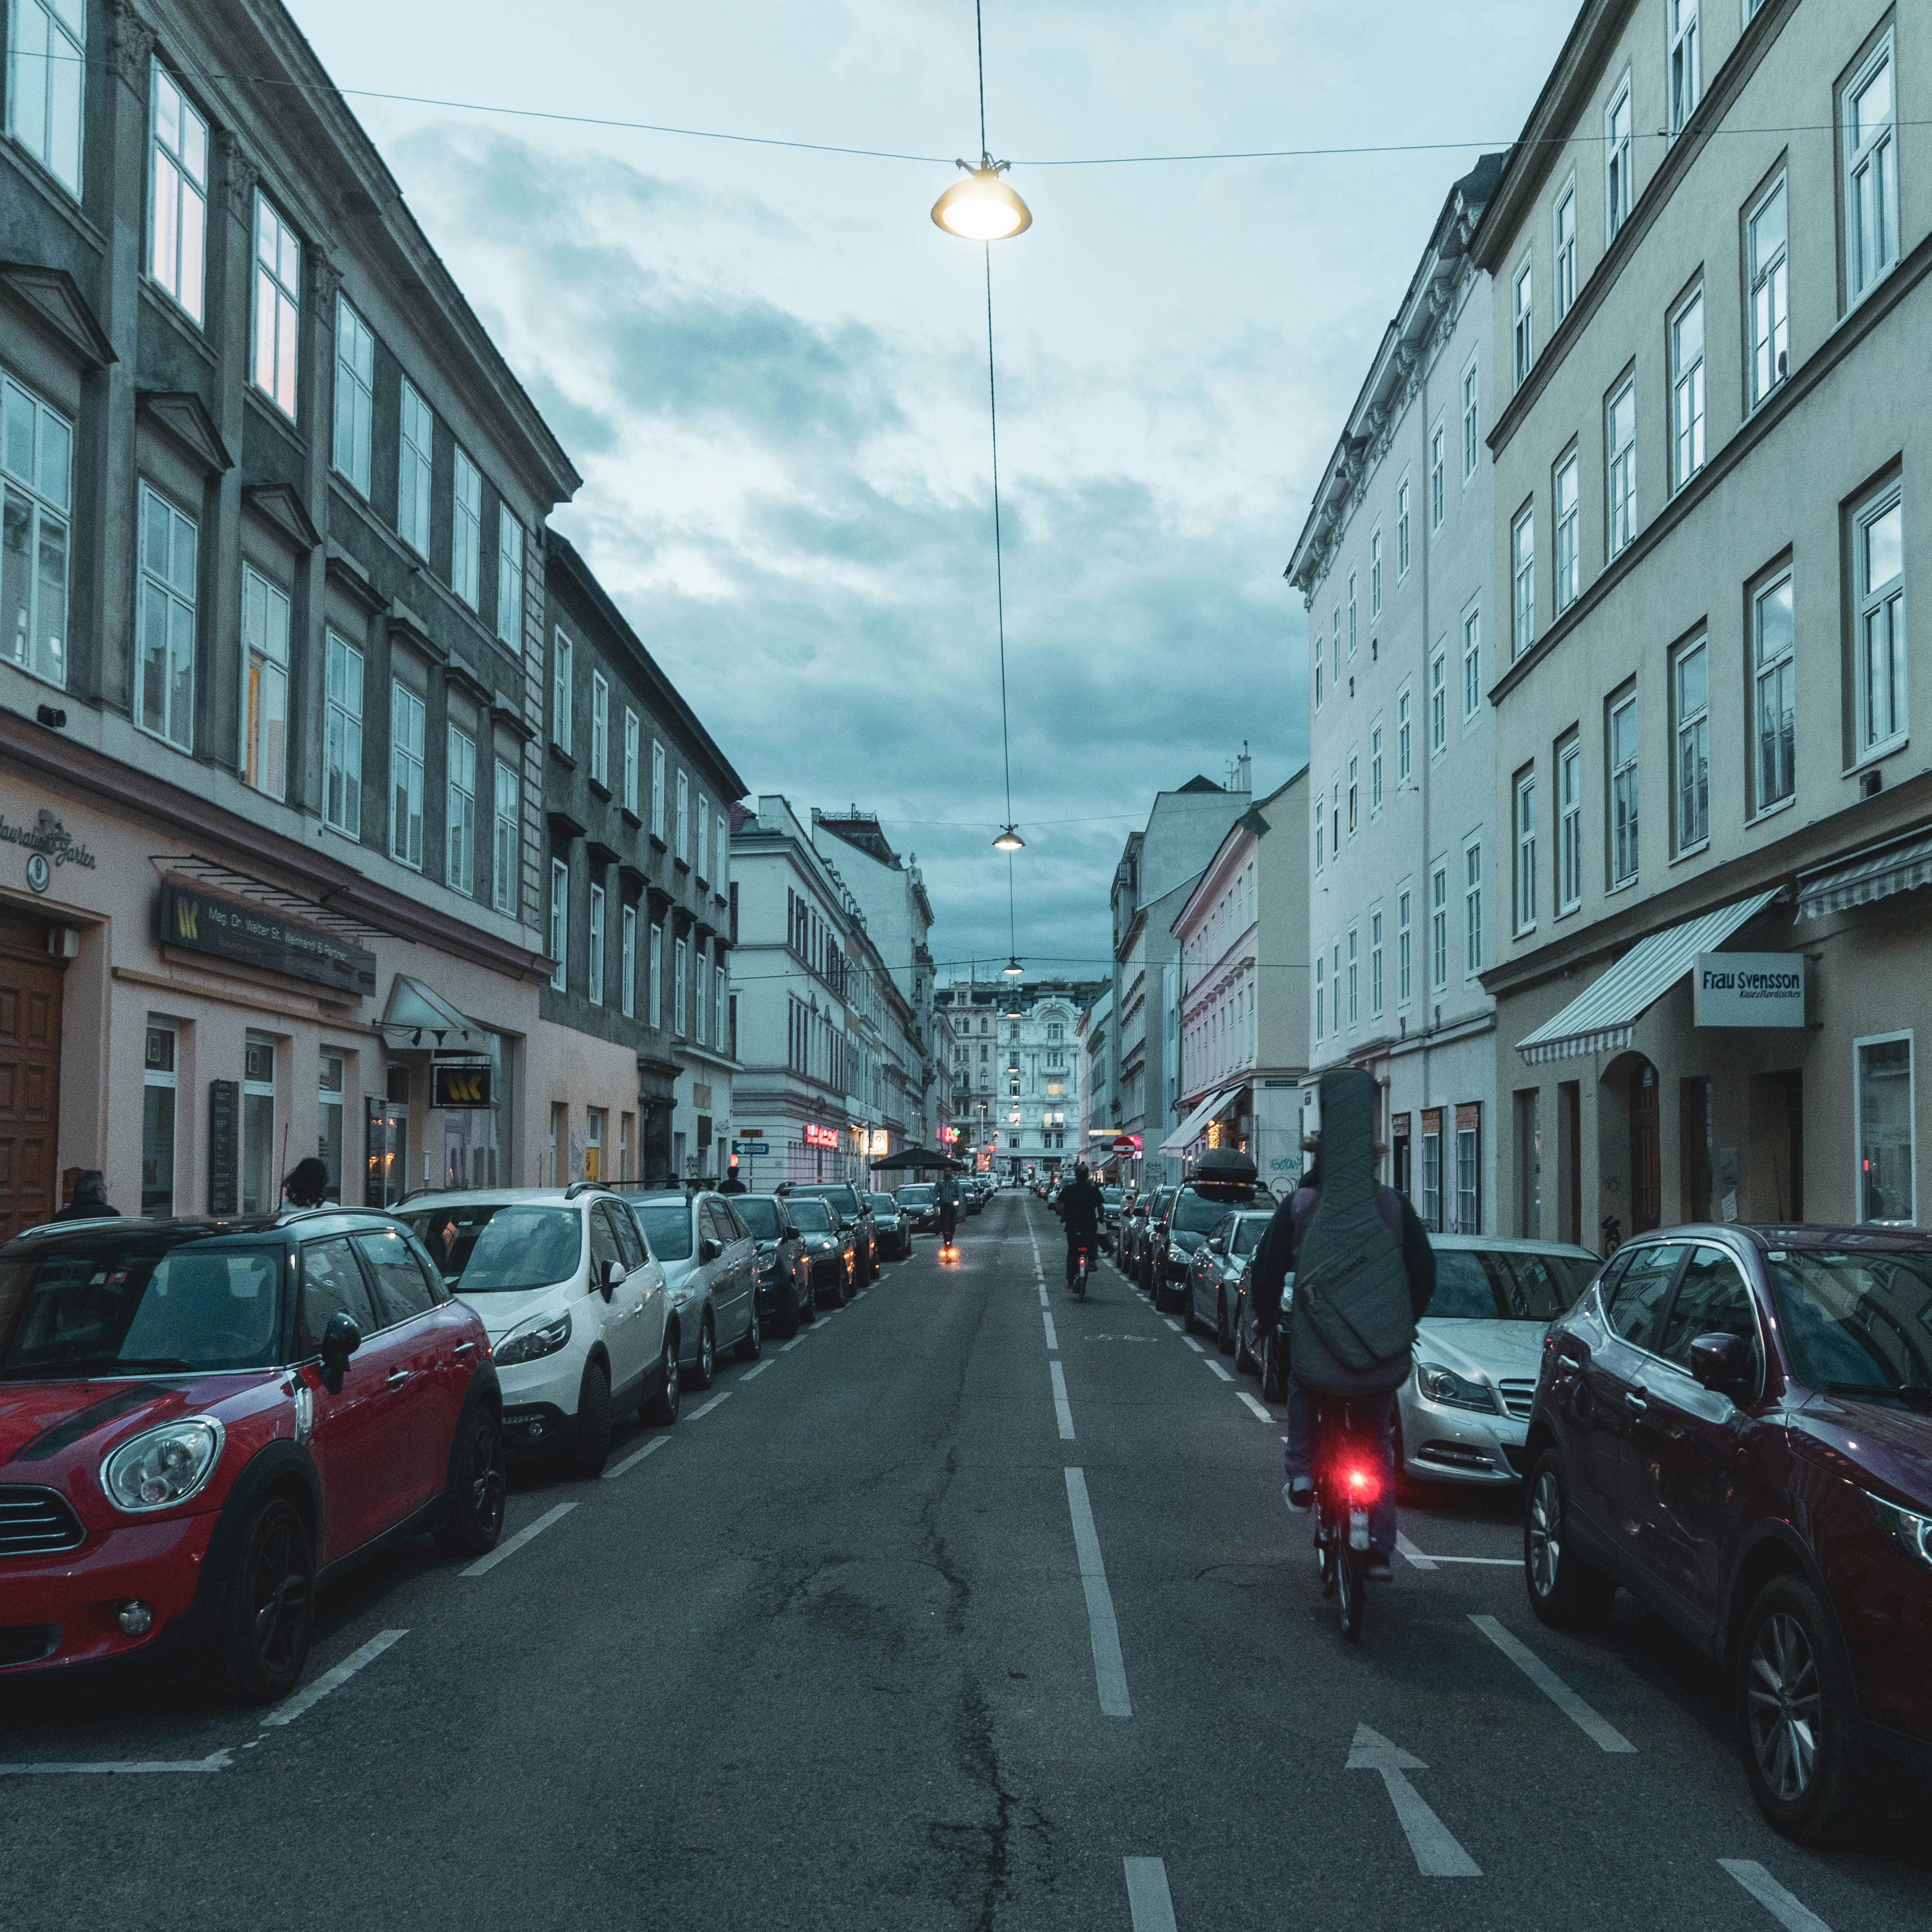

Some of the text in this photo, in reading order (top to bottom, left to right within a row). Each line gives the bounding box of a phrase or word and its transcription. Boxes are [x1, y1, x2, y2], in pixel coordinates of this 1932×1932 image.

[209, 907, 228, 926] Mag.
[231, 914, 243, 928] Dr.
[324, 944, 347, 960] Partner
[1703, 971, 1800, 990] Frau Svensson
